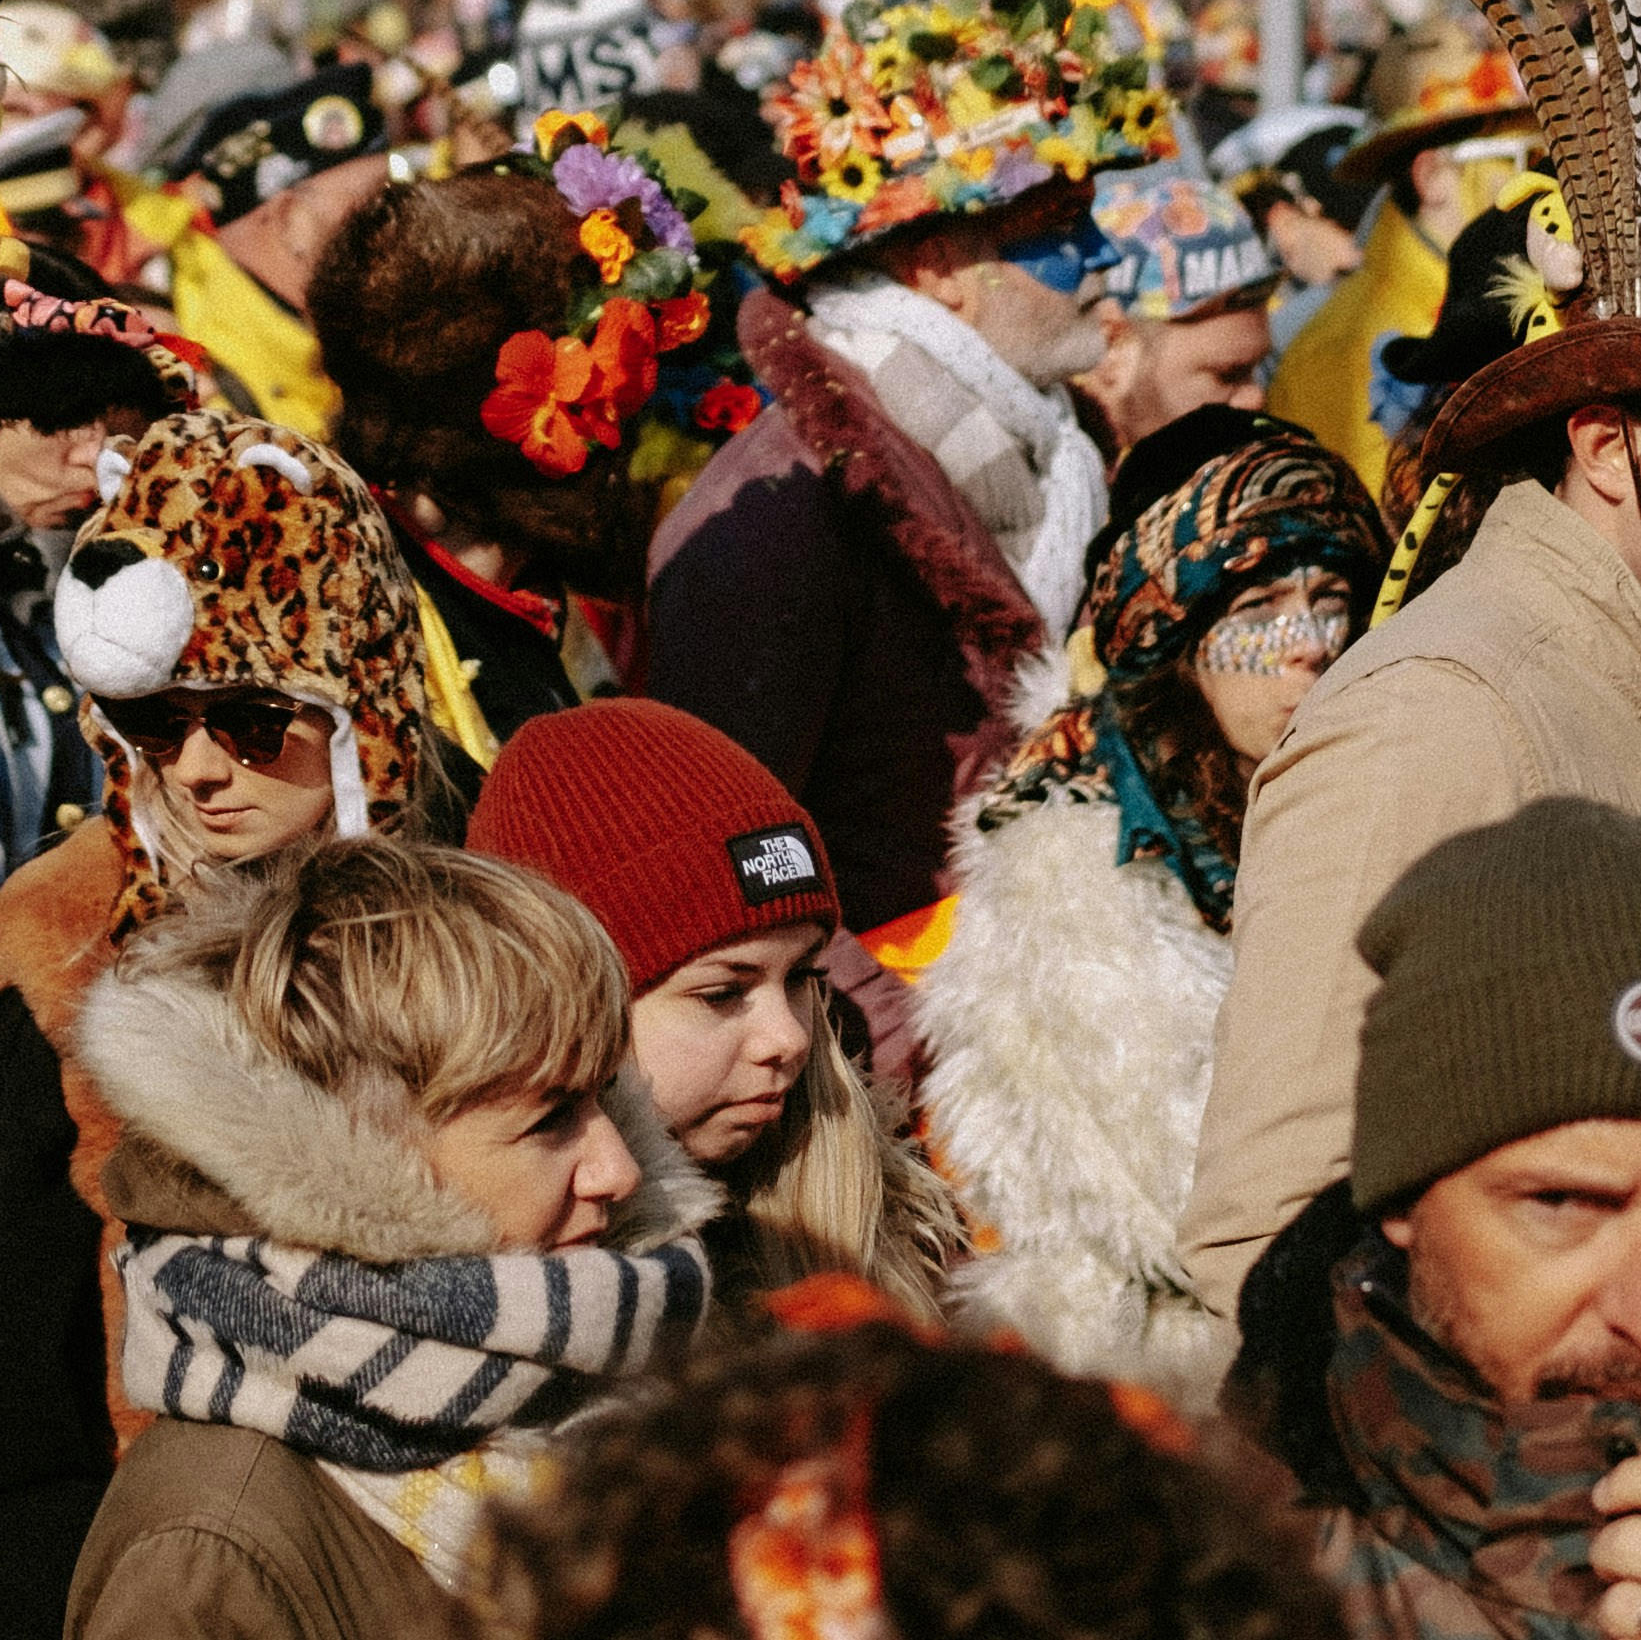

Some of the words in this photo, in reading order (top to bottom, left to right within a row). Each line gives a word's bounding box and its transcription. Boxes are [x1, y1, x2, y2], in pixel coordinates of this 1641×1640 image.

[759, 836, 789, 854] THE
[742, 849, 793, 877] NORTH
[762, 864, 800, 886] FACE
